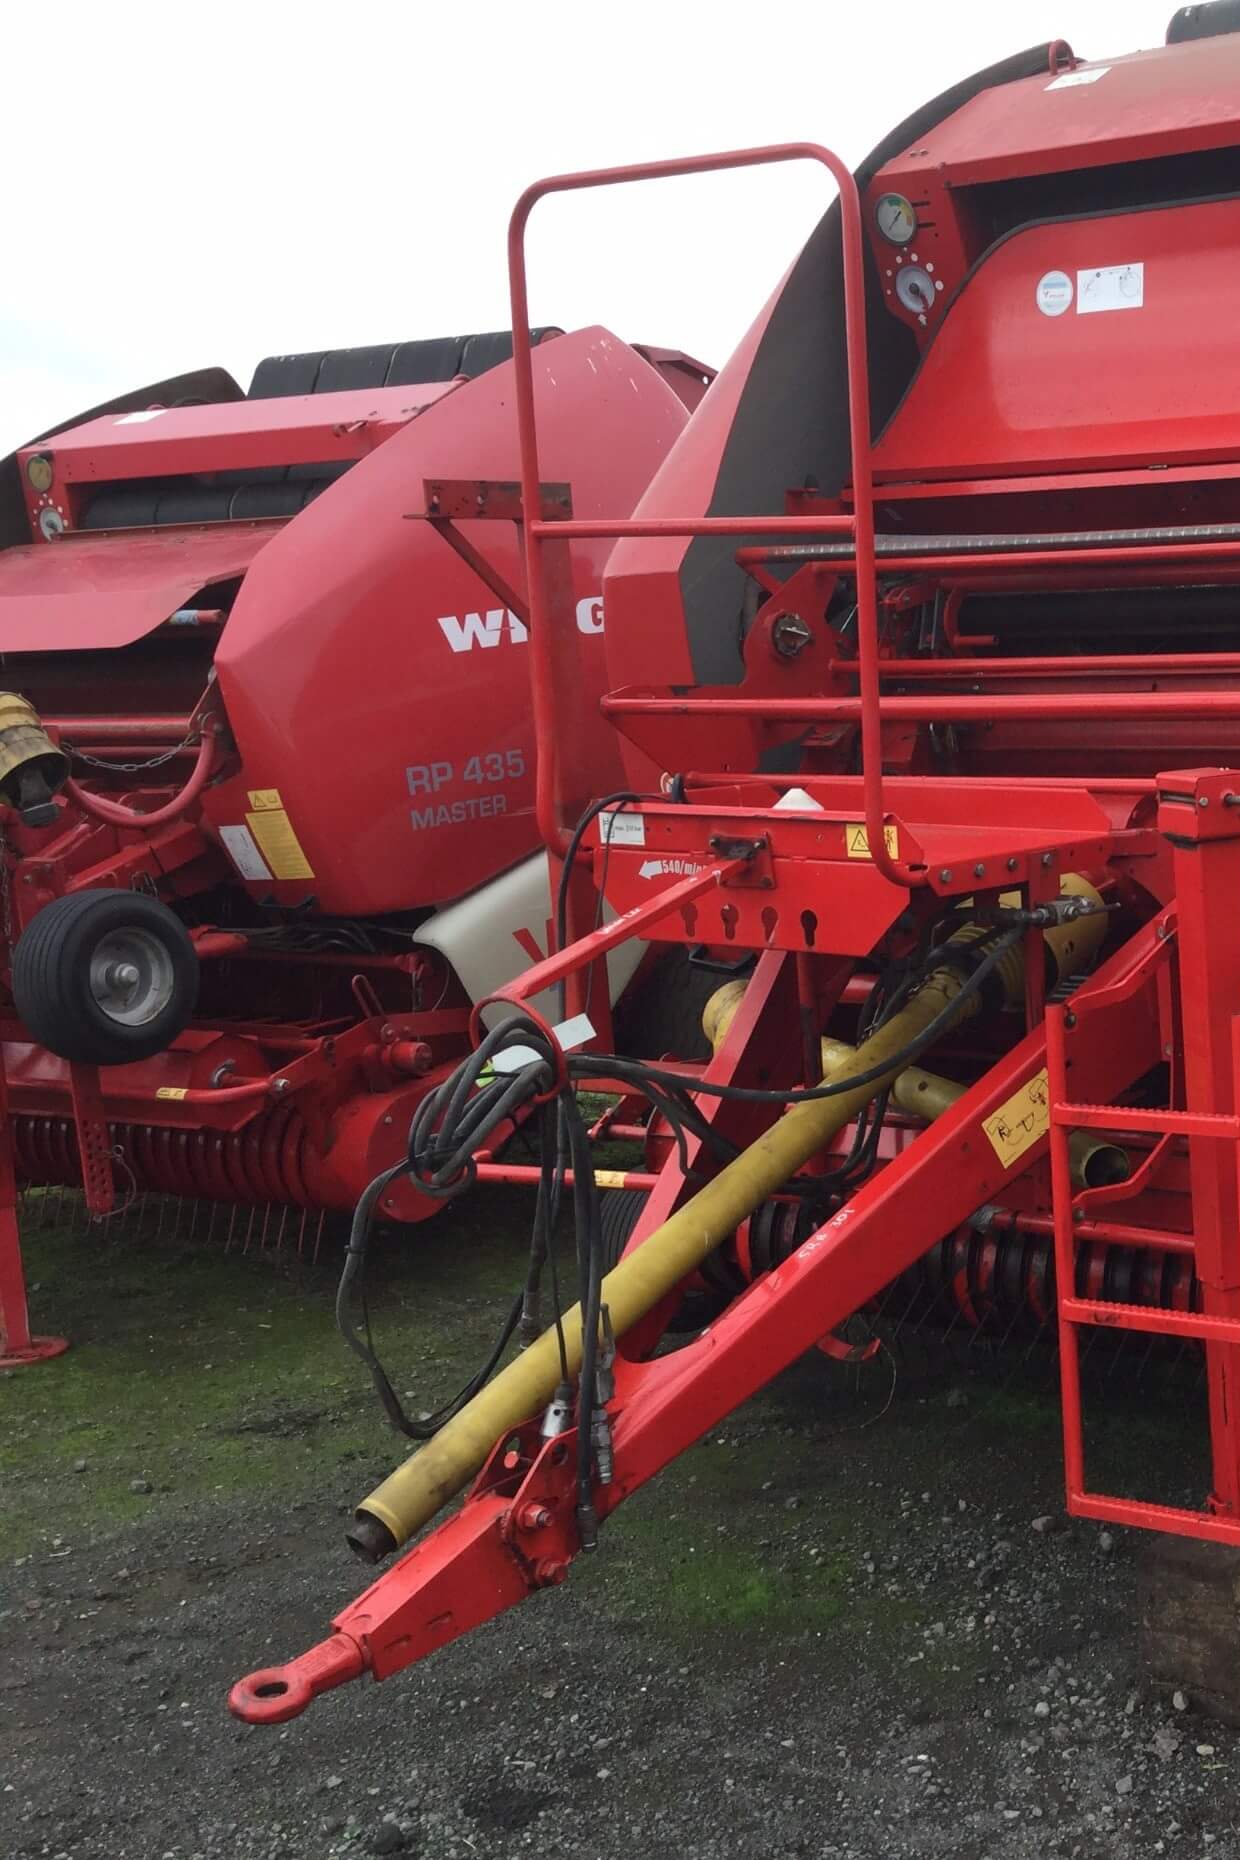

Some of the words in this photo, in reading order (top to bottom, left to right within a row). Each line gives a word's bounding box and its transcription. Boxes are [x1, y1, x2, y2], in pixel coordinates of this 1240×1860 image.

[406, 761, 453, 796] RP
[463, 749, 526, 785] 435
[410, 794, 507, 831] MASTER
